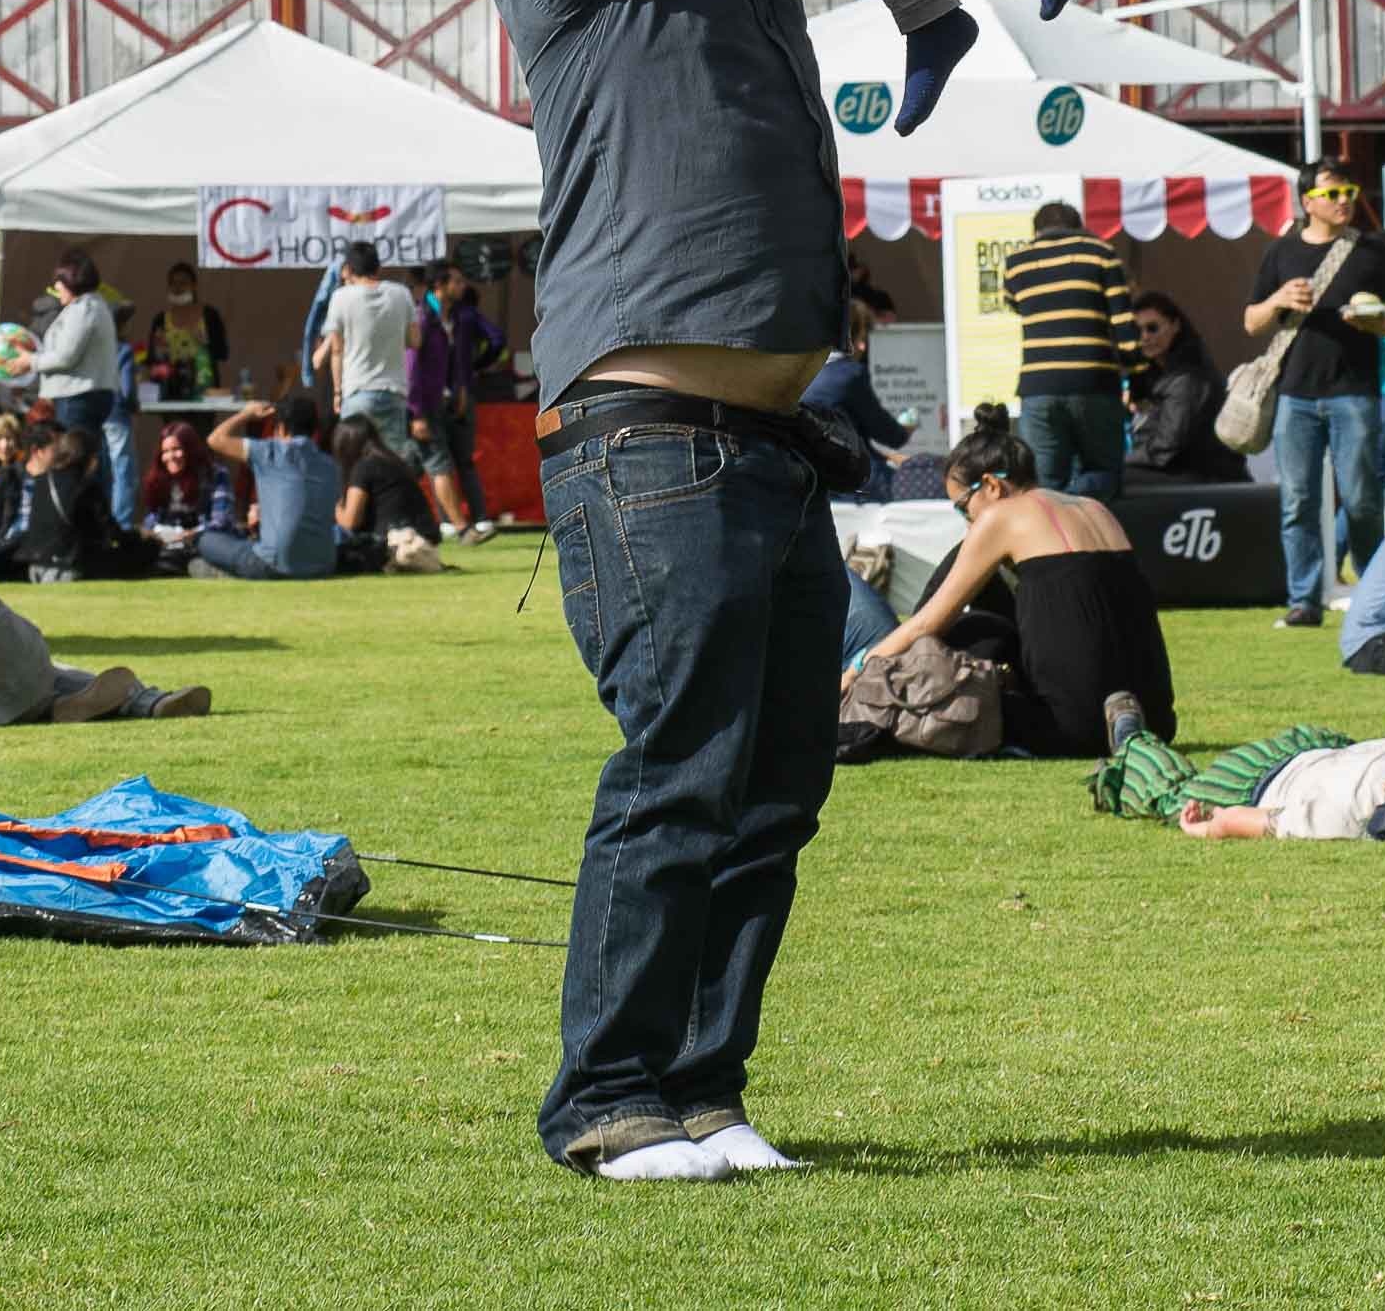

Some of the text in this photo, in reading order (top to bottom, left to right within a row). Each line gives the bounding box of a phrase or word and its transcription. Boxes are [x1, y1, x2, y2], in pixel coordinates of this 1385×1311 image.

[838, 83, 889, 125] eTb
[1039, 93, 1083, 136] eTb
[1163, 508, 1222, 561] eTb
